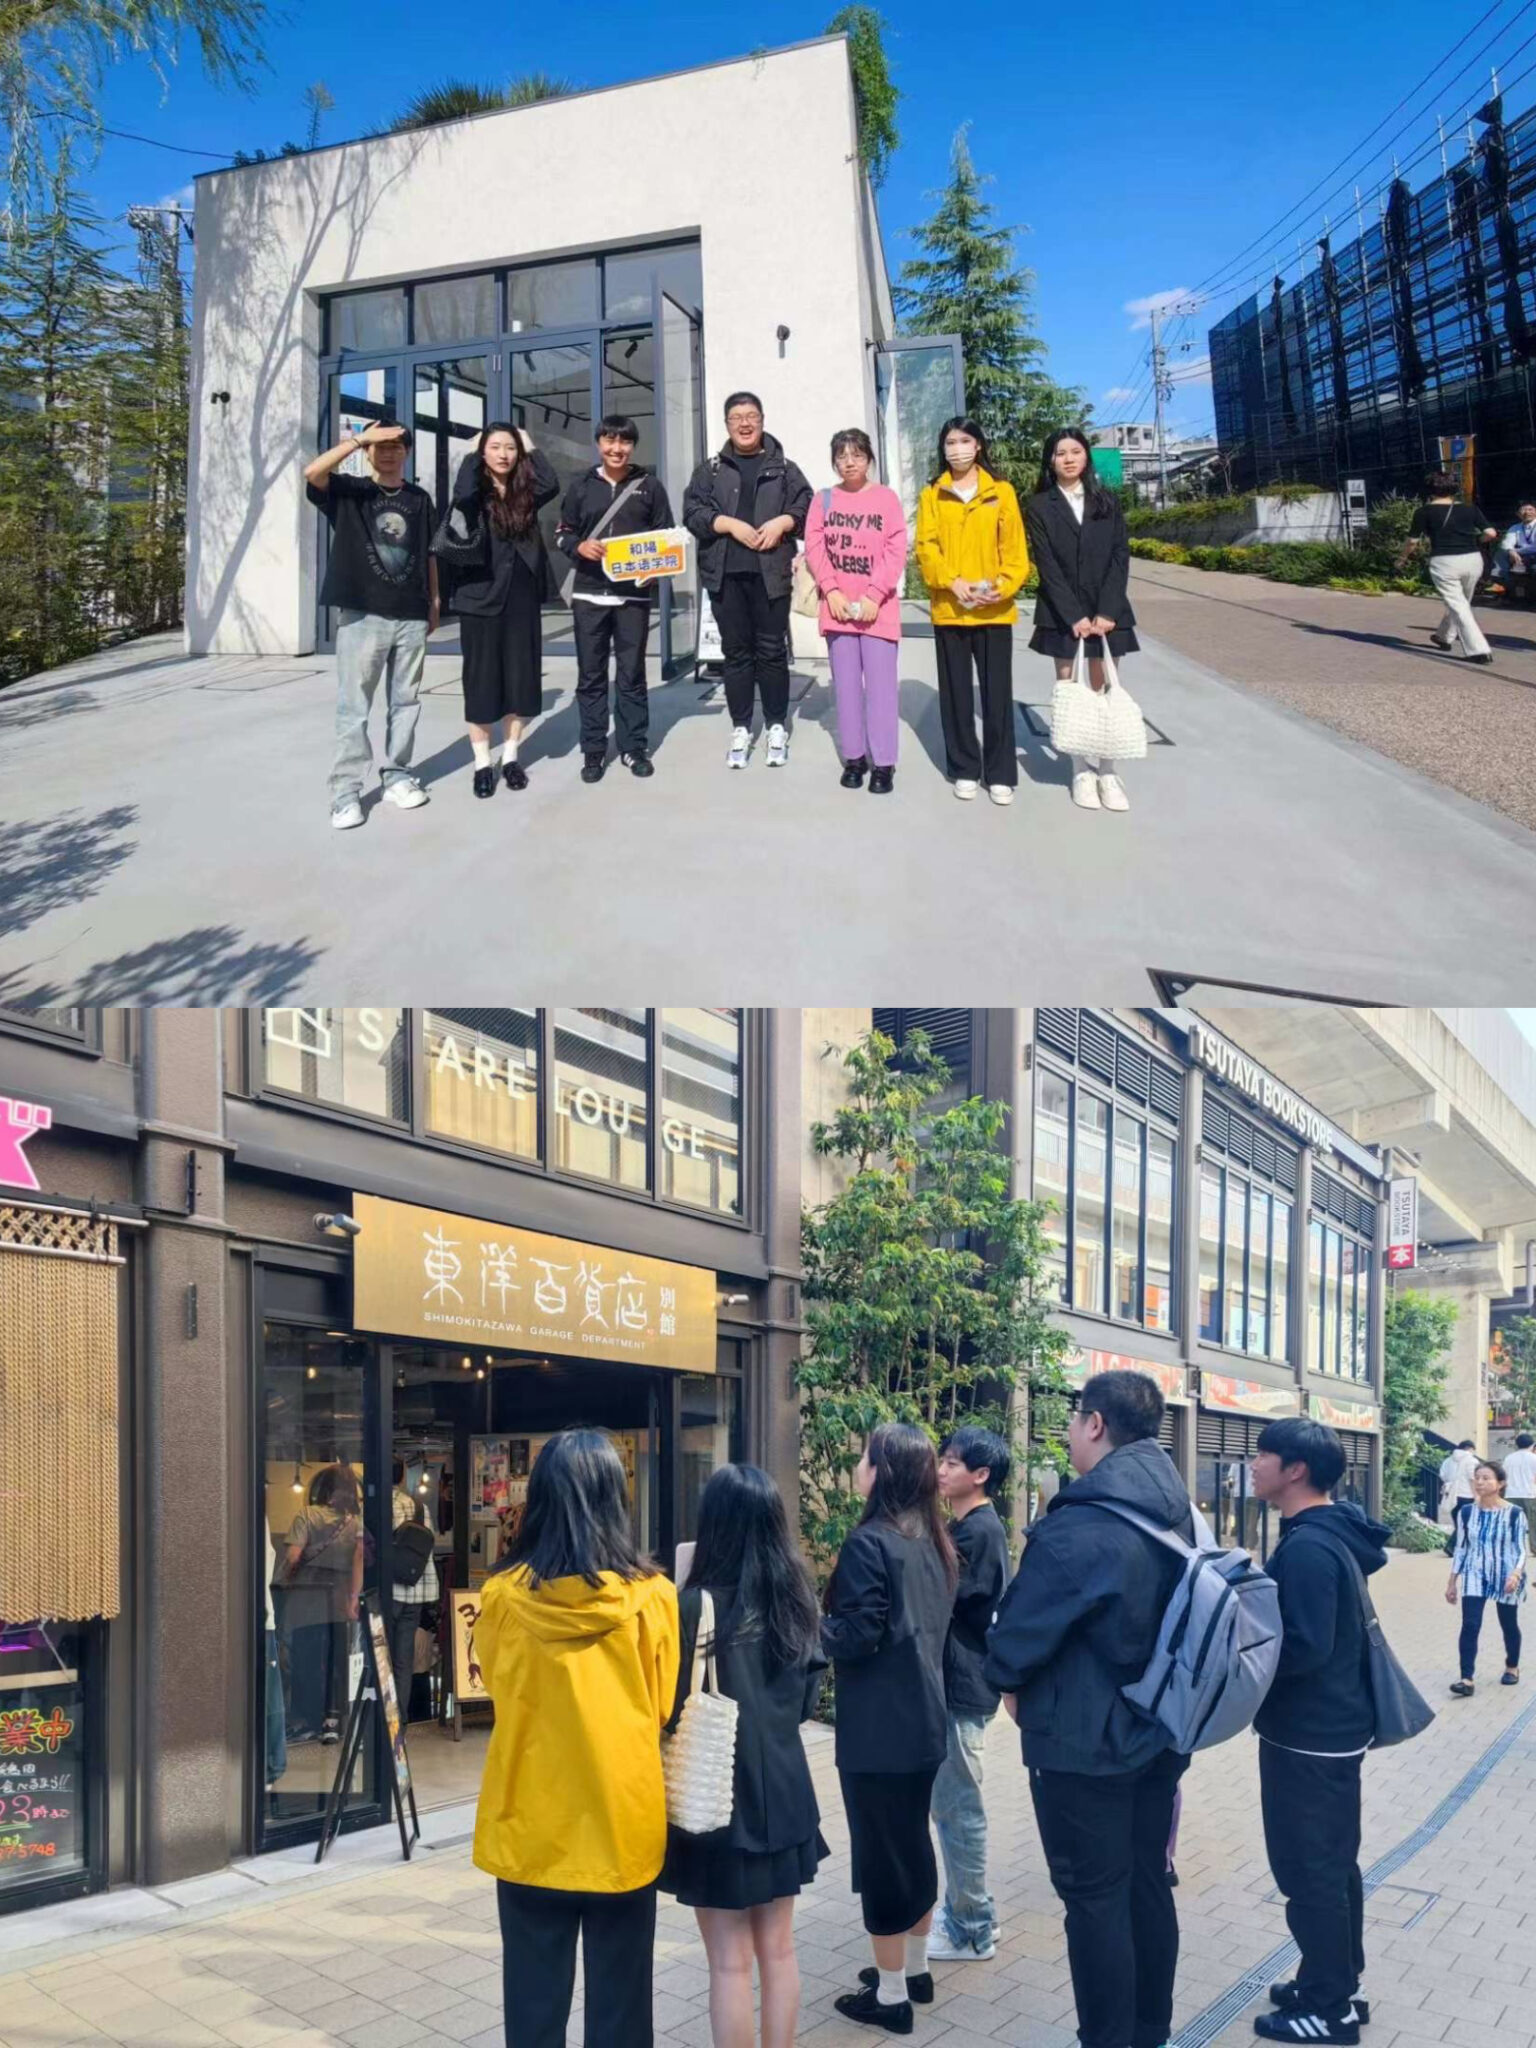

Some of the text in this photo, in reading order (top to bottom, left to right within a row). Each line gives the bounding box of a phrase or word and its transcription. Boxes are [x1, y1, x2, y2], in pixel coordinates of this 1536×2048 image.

[867, 514, 882, 531] ME
[1197, 1025, 1333, 1153] TSUTAYA BOOKSTORE
[1402, 1190, 1411, 1236] TSUTAYA
[1391, 1246, 1412, 1264] 本
[423, 1311, 646, 1351] SHIMOKITAZAWA GARAGE DEPARTMENT
